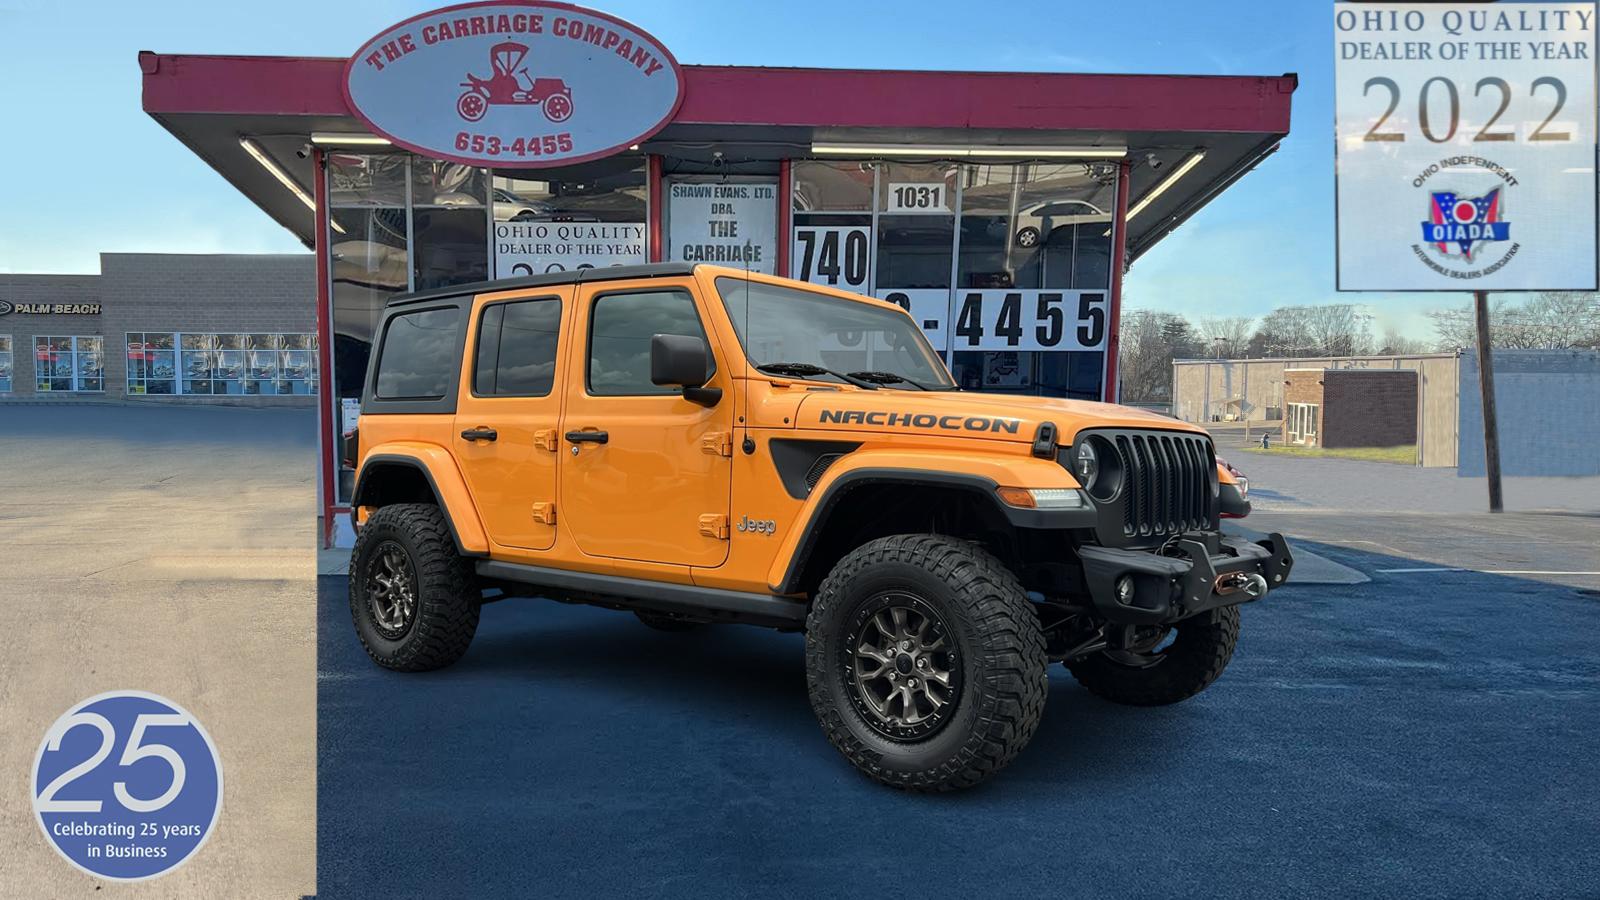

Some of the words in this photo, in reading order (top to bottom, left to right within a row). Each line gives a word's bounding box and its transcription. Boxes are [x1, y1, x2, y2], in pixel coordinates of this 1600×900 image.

[1336, 10, 1425, 31] OHIO
[1441, 10, 1593, 35] QUALITY
[366, 33, 417, 72] THE
[422, 14, 544, 46] CARRIAGE
[553, 17, 664, 77] COMPANY
[1340, 42, 1433, 60] DEALER
[1438, 41, 1469, 60] OF
[1475, 42, 1522, 60] THE
[1528, 42, 1589, 60] YEAR
[1362, 76, 1571, 143] 2022
[454, 132, 574, 156] 653-4455
[1412, 164, 1439, 188] OHIO
[1440, 156, 1519, 187] INDEPENDENT
[673, 186, 712, 198] SHAWN
[754, 187, 774, 199] LTD.
[894, 186, 941, 209] 1031
[711, 203, 736, 215] DBA.
[497, 226, 548, 238] OHIO
[557, 226, 644, 241] QUALITY
[708, 220, 738, 238] THE
[1432, 224, 1495, 240] OIADA
[500, 244, 552, 255] DEALER
[555, 244, 574, 255] OF
[576, 244, 602, 255] THE
[606, 244, 641, 256] YEAR
[683, 244, 762, 262] CARRIAGE
[797, 230, 869, 286] 740
[15, 303, 51, 314] PALM
[54, 303, 100, 314] BEACH
[819, 409, 1021, 434] NACHOCON
[736, 514, 777, 536] Jeep
